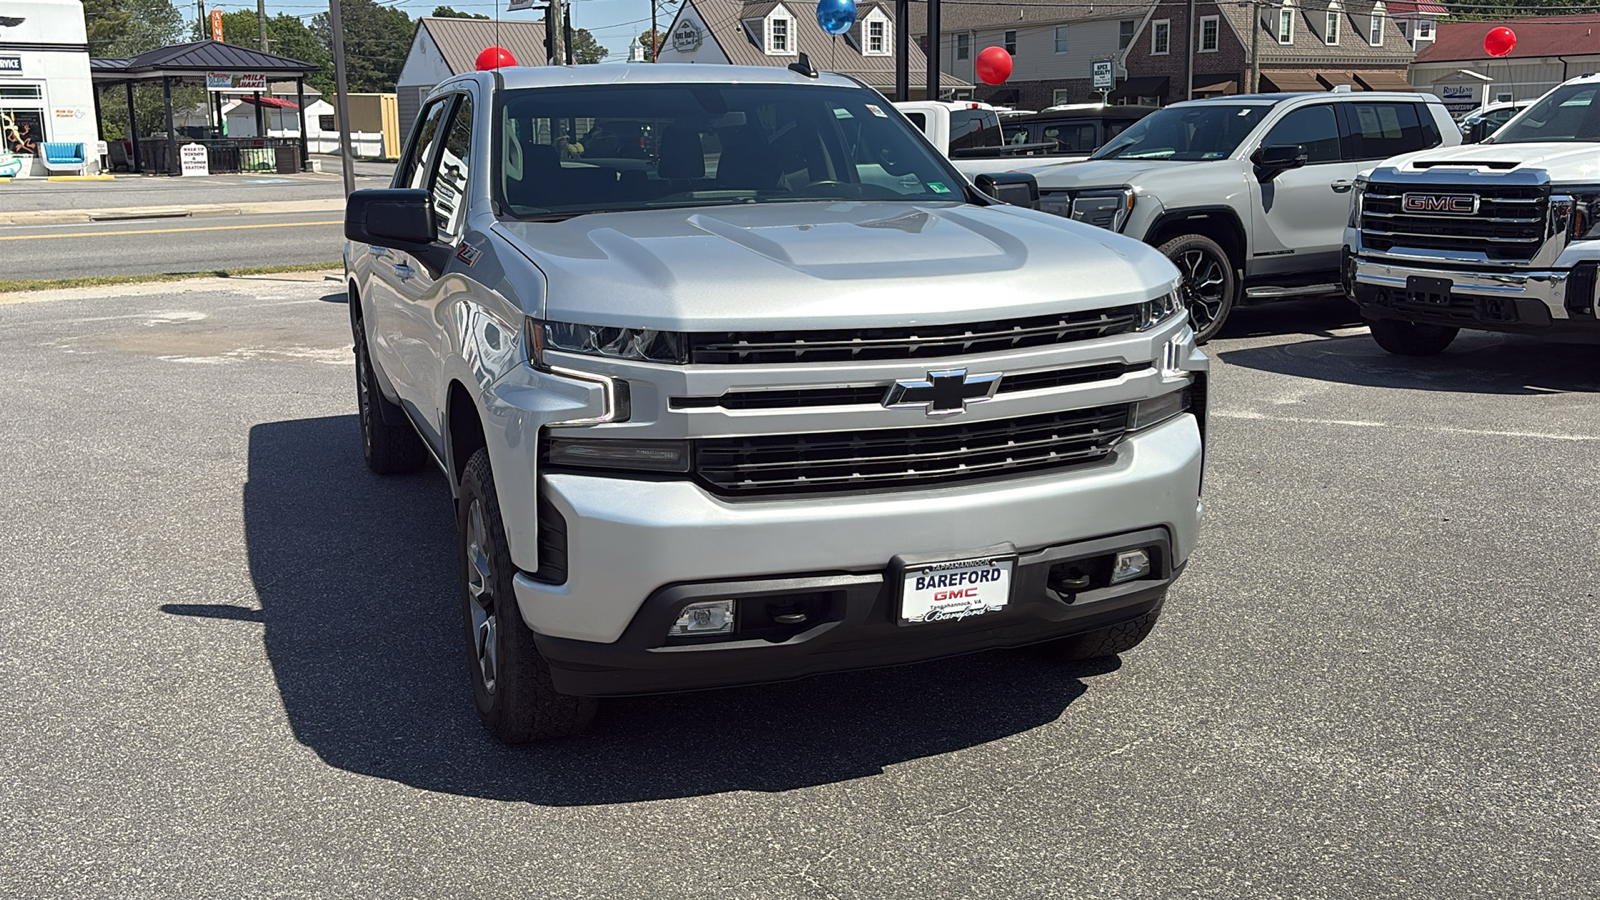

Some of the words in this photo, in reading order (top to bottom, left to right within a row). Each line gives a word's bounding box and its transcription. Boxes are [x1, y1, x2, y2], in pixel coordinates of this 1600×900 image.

[1406, 196, 1473, 211] GMC
[455, 241, 483, 268] Z71
[932, 559, 990, 570] TAPPAHANNOCK
[915, 568, 1001, 590] BAREFORD
[934, 587, 978, 601] GMC
[924, 603, 988, 622] Bareford
